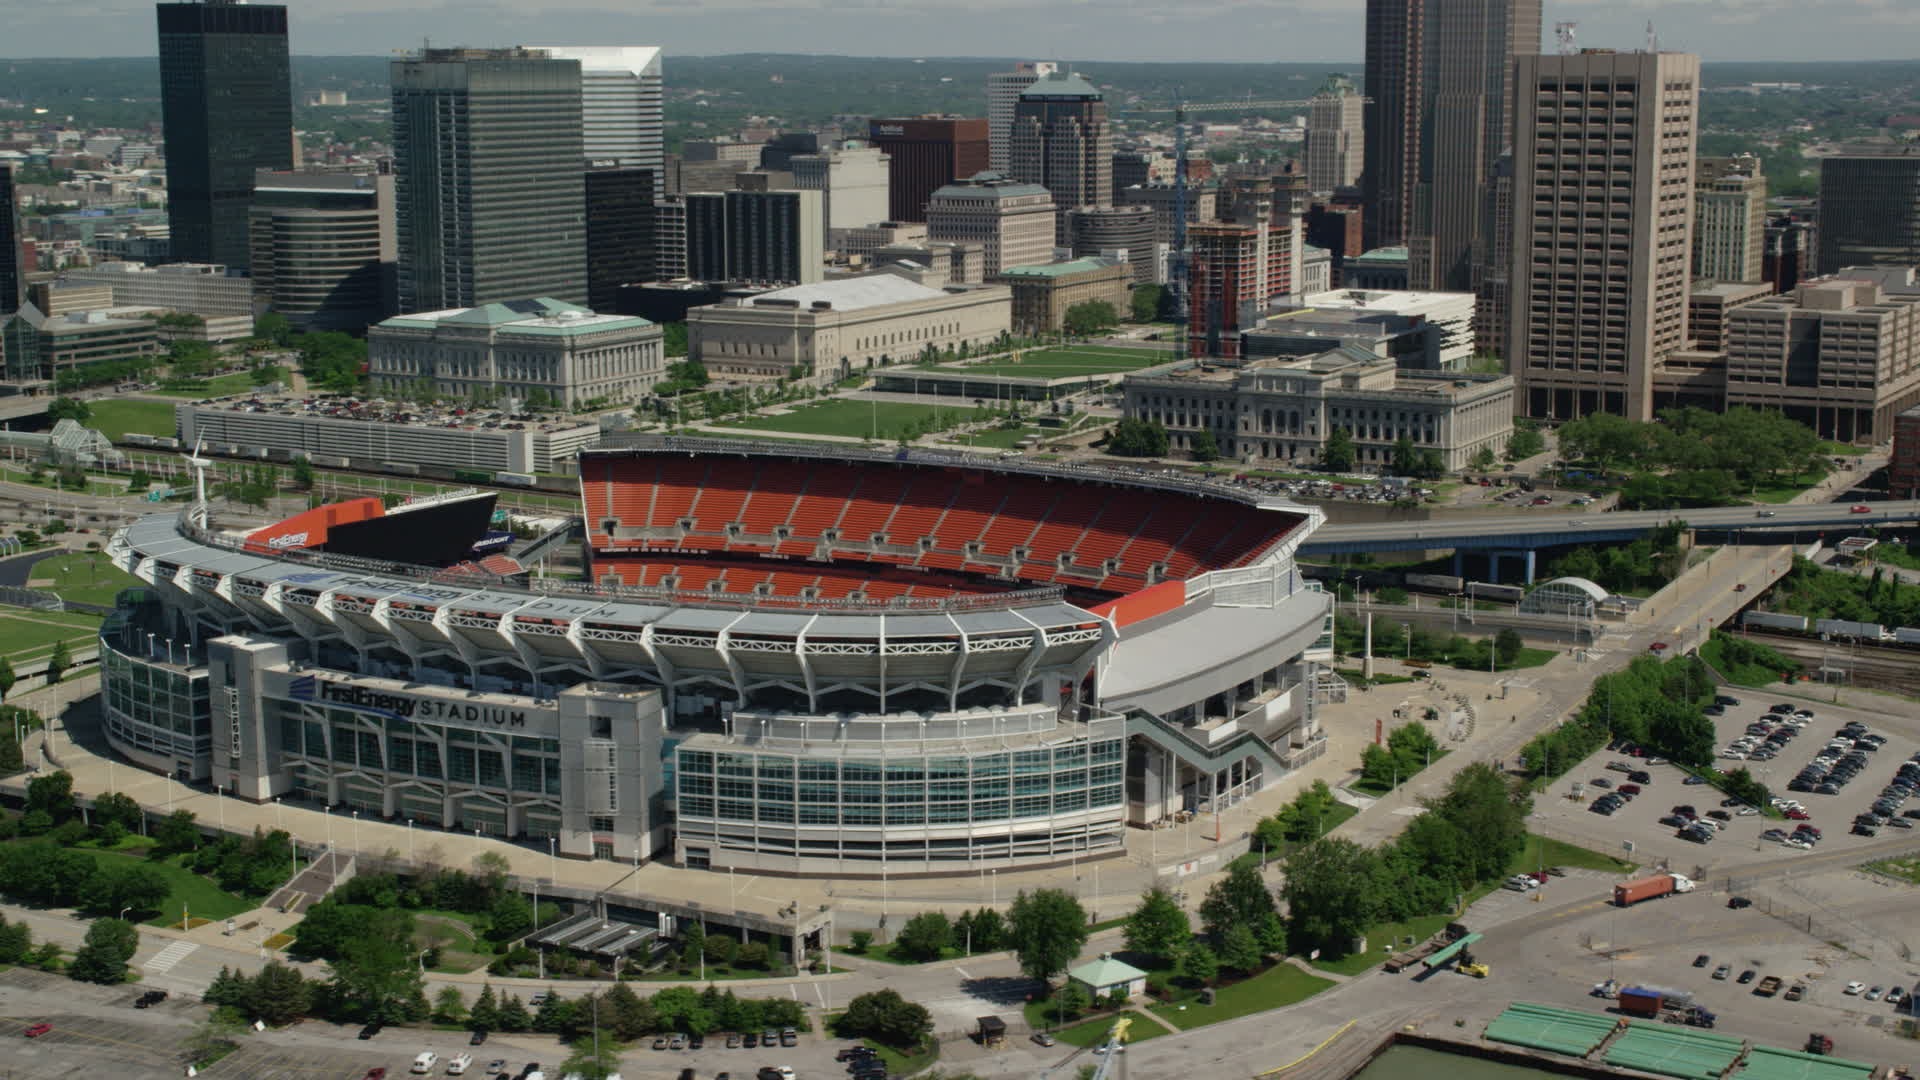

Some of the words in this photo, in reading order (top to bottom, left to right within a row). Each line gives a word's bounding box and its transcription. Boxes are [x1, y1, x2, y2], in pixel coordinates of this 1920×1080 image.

[470, 594, 617, 617] STADIUM
[322, 681, 416, 716] FirstEnergy
[421, 700, 525, 727] STADIUM
